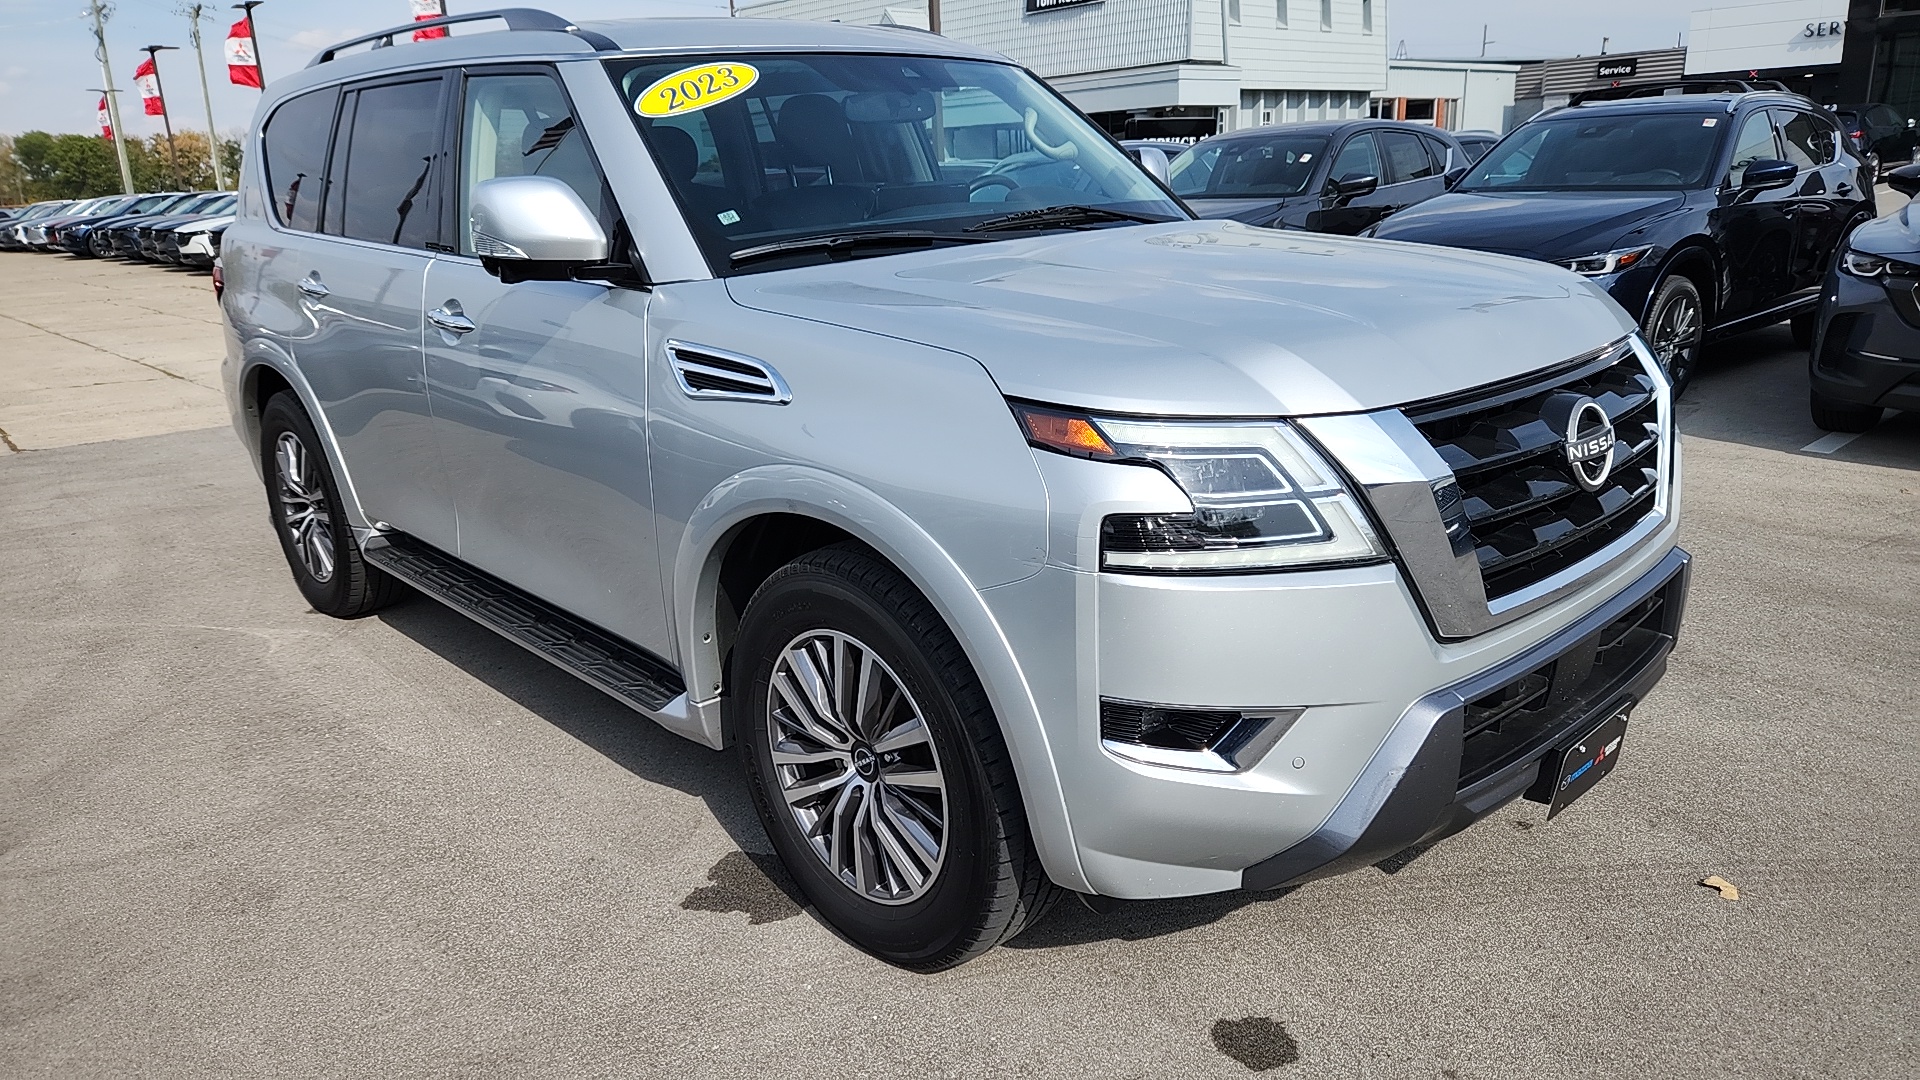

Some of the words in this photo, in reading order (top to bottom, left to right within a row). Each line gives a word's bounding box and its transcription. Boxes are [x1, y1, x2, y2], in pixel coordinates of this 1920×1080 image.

[1599, 65, 1632, 76] Service
[660, 67, 740, 111] 2023
[1568, 433, 1614, 461] NISSA
